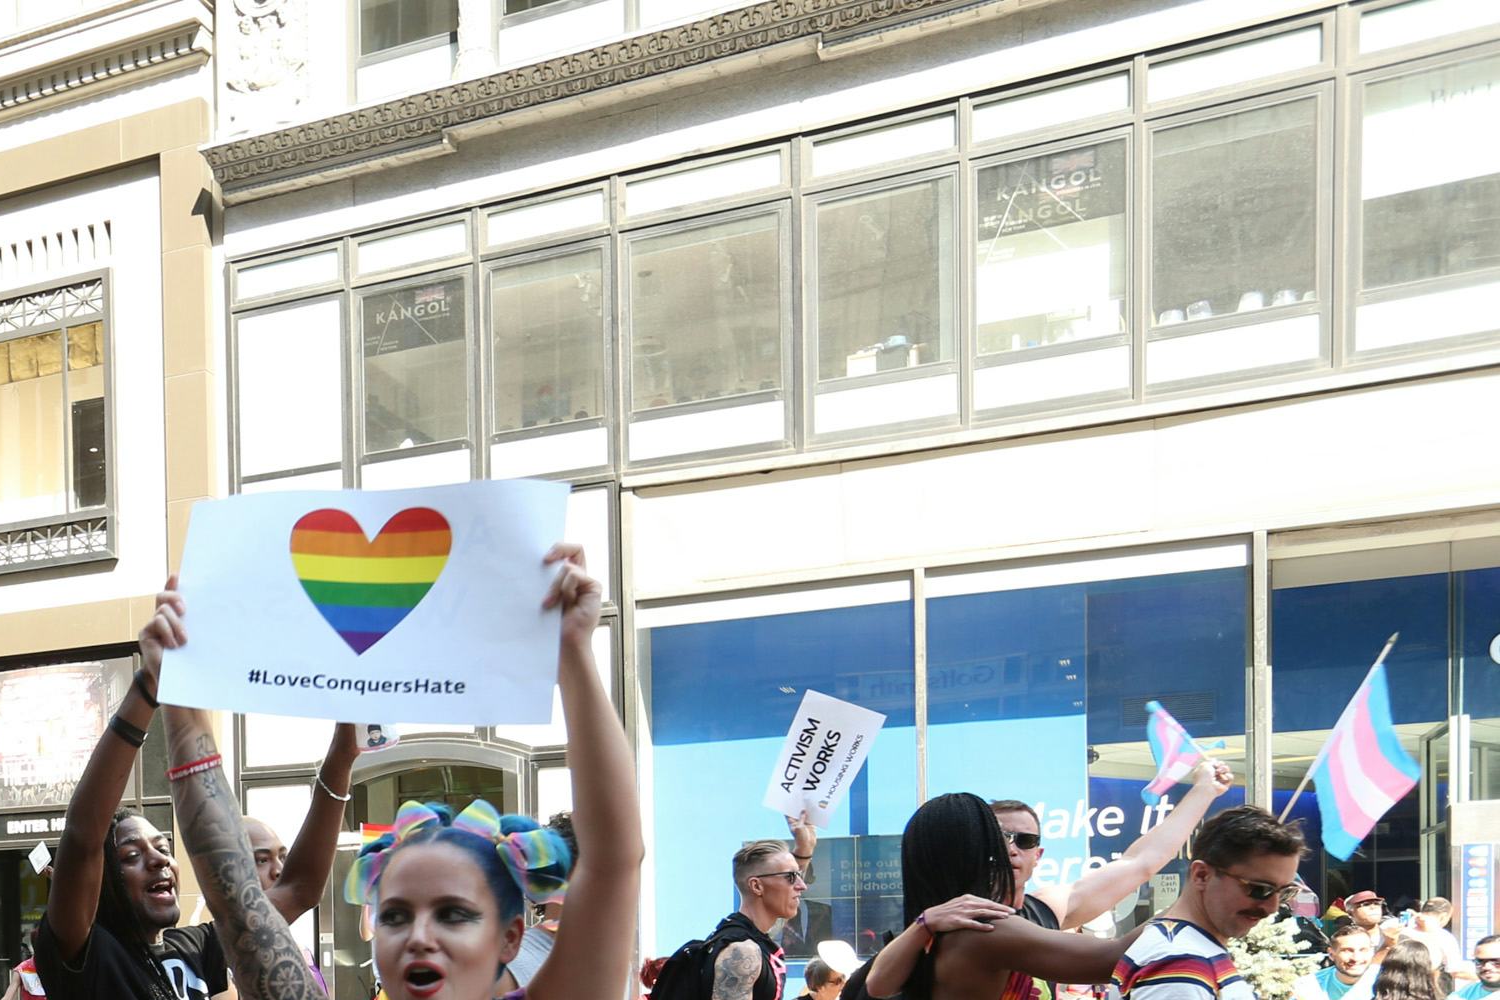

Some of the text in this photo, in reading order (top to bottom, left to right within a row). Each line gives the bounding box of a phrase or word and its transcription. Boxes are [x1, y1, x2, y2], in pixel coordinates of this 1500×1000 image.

[997, 168, 1101, 201] KANGOL
[375, 300, 450, 325] KANGOL
[248, 668, 466, 696] #LoveConquersHate
[780, 717, 821, 794] ACTIVISM
[802, 729, 842, 791] WORKS
[7, 818, 49, 834] ENTER
